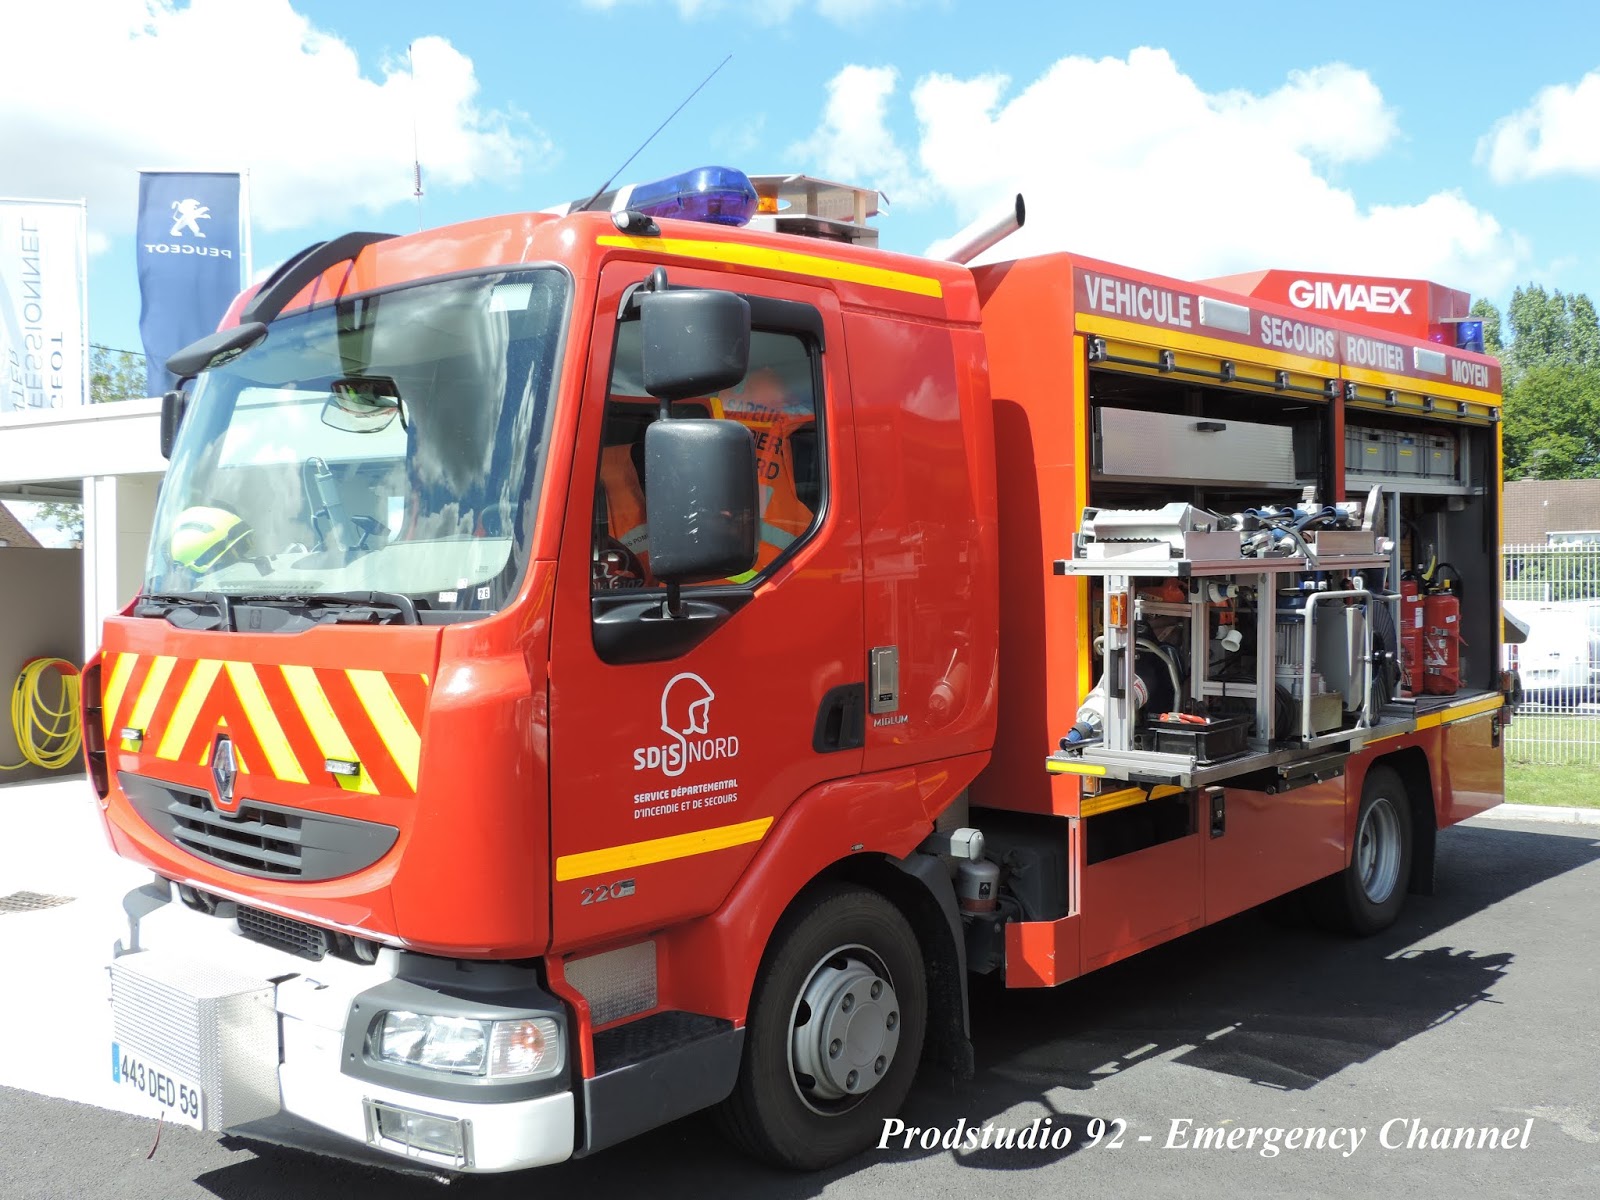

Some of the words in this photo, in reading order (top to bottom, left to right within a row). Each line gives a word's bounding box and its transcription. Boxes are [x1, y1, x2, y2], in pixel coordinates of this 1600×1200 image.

[1288, 279, 1412, 315] GIMAEX
[1084, 274, 1192, 328] VEHICULE
[1260, 315, 1335, 358] SECOURS
[1347, 336, 1405, 371] ROUTIER
[1452, 359, 1489, 388] MOYEN
[873, 715, 908, 727] MIDLUM
[688, 736, 739, 763] NORD
[633, 789, 670, 804] SERVICE
[671, 779, 738, 798] DÉPARTEMENTAL
[681, 801, 691, 811] ET
[692, 799, 702, 809] DE
[704, 793, 738, 807] SECOURS
[581, 881, 622, 906] 220
[121, 1055, 146, 1092] 443
[148, 1068, 176, 1108] DED
[180, 1084, 198, 1119] 59
